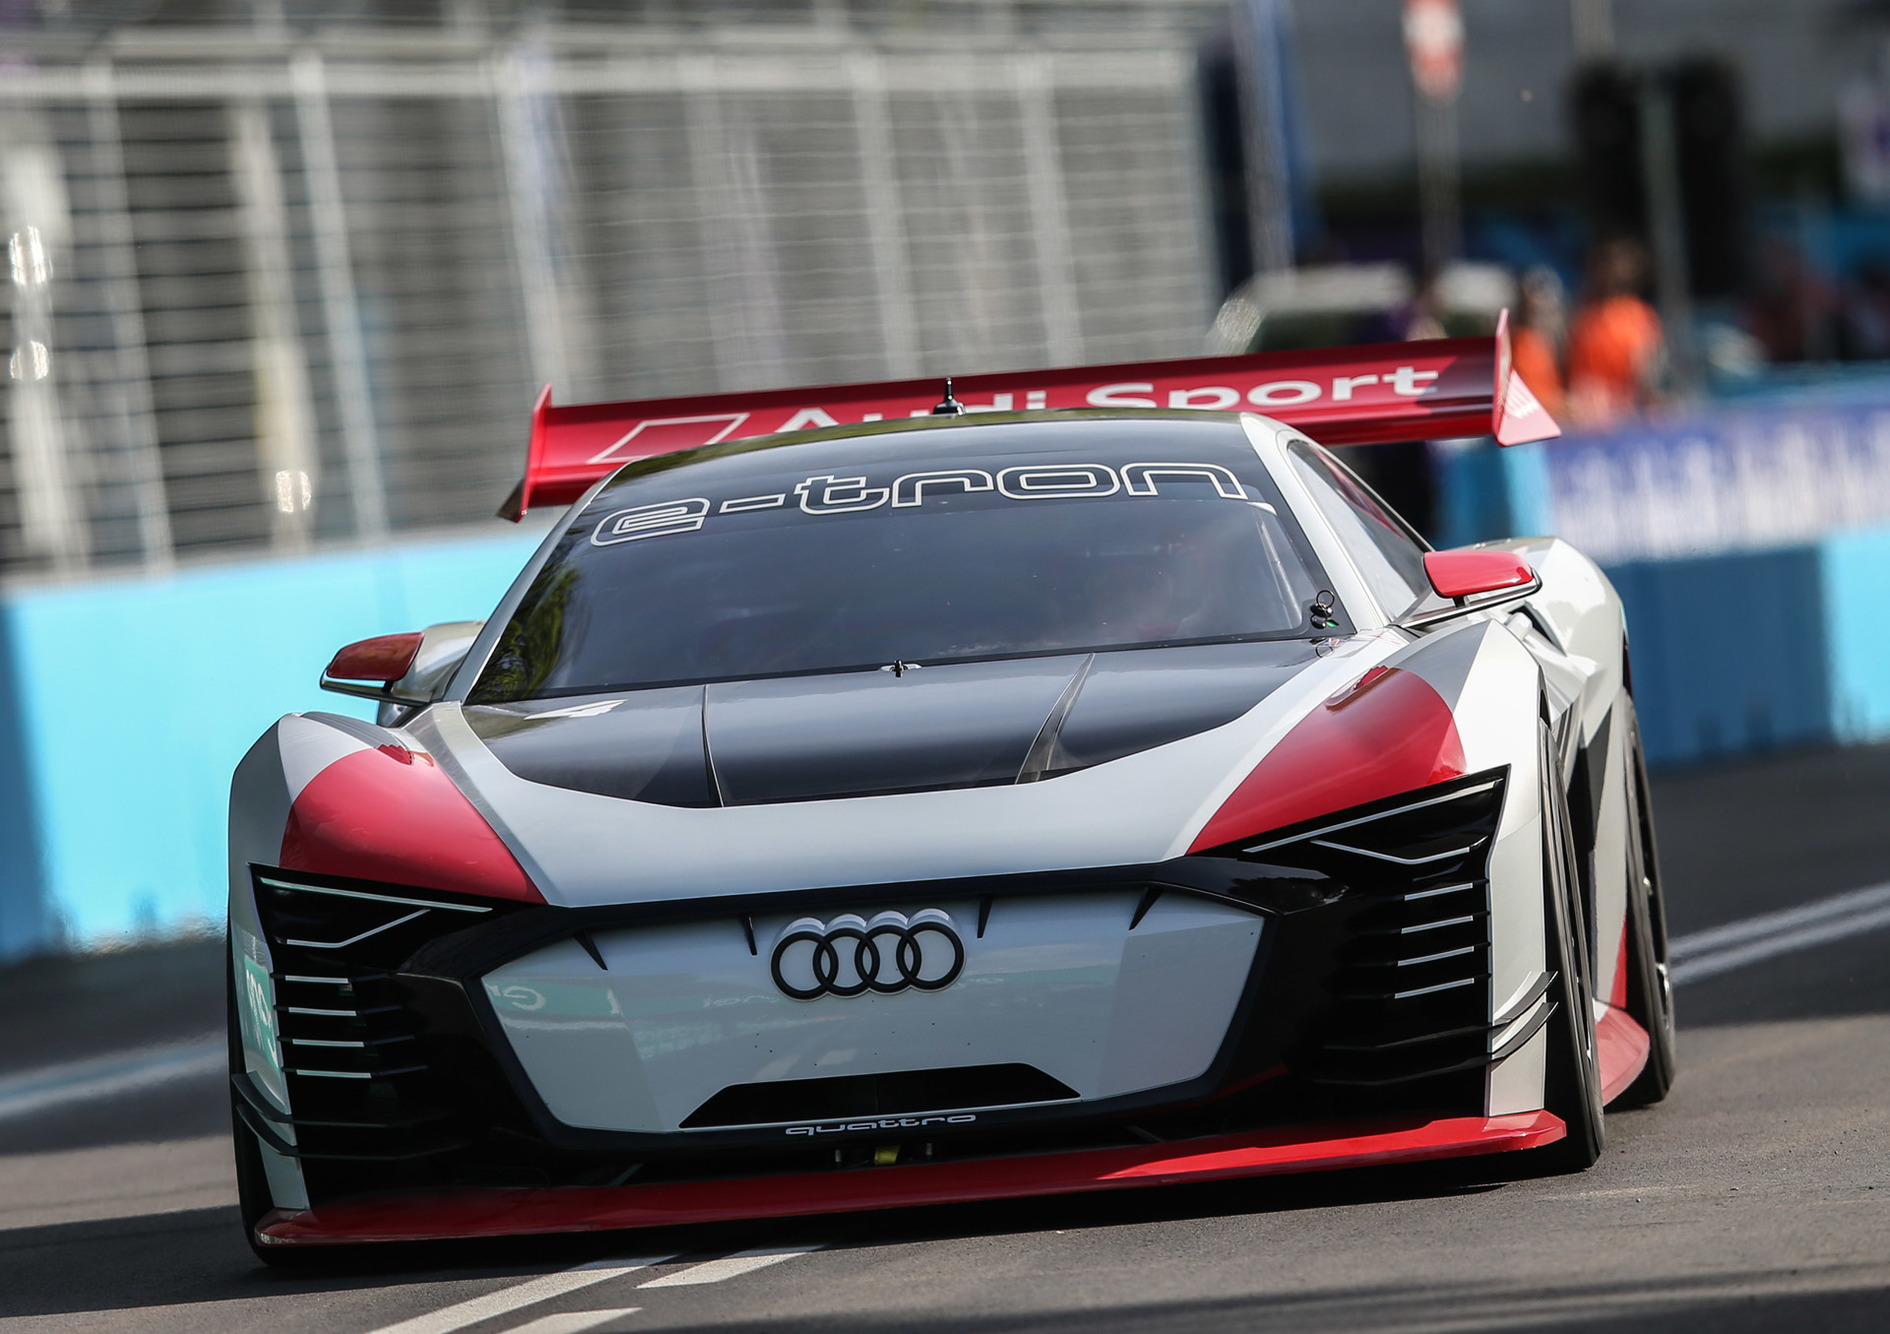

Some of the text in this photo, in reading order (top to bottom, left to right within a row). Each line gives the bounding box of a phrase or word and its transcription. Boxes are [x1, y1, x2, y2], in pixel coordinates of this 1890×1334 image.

[775, 366, 1439, 433] Ai Sport
[590, 462, 1249, 547] e-tron
[785, 1114, 977, 1136] quattro
